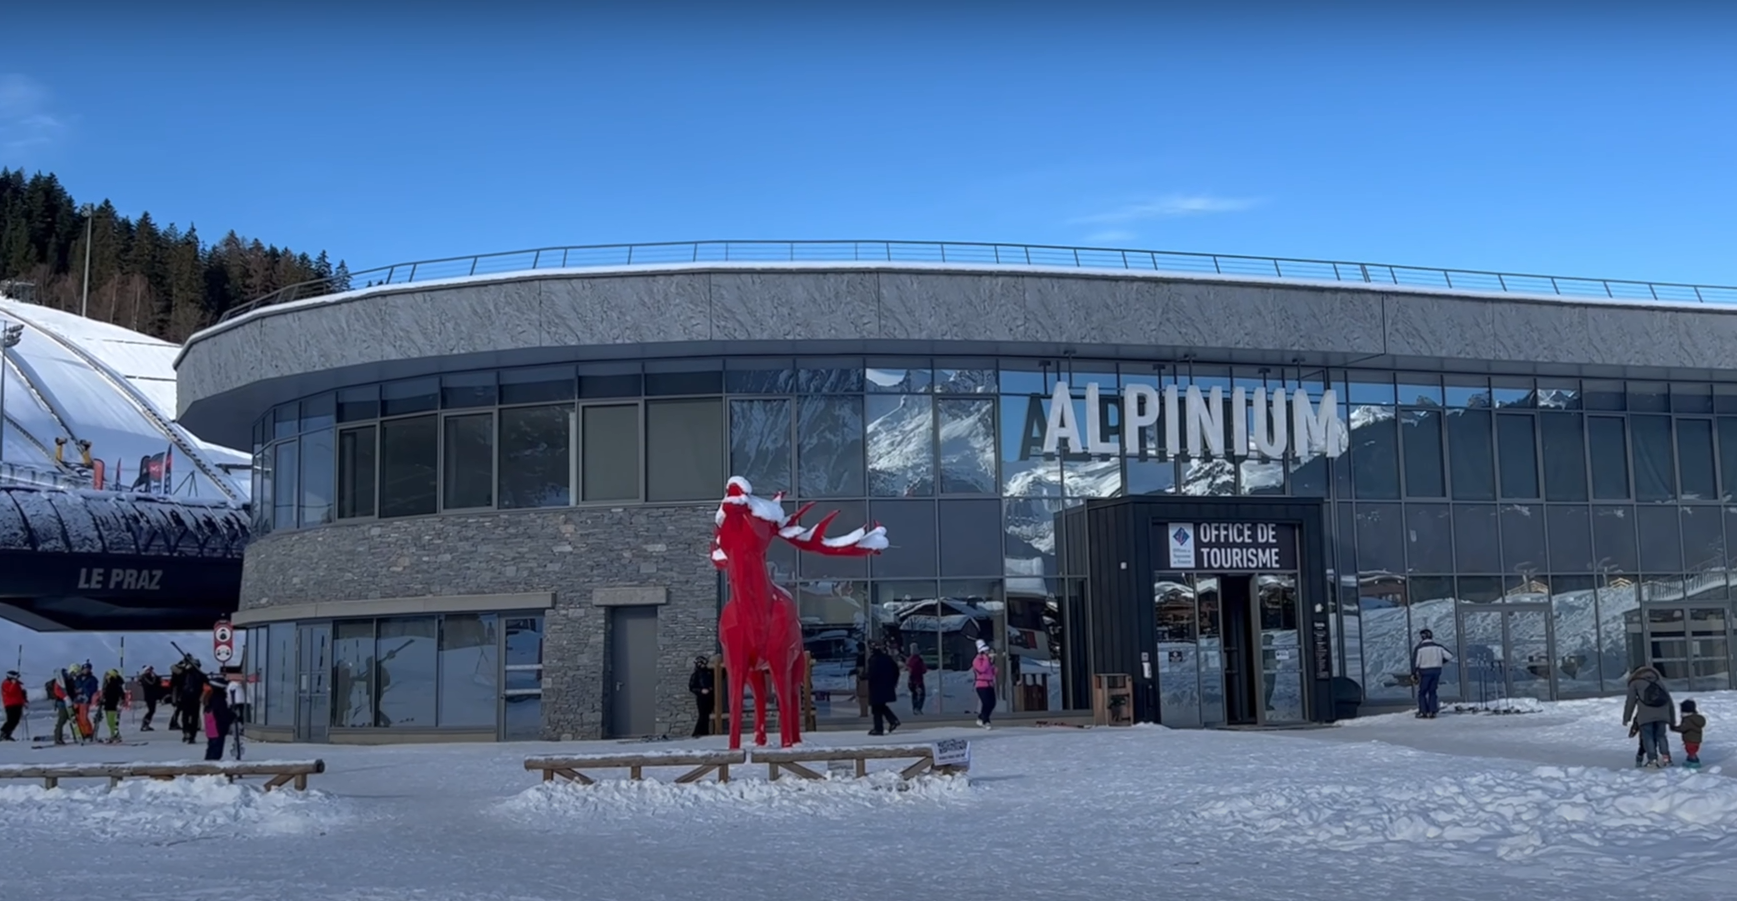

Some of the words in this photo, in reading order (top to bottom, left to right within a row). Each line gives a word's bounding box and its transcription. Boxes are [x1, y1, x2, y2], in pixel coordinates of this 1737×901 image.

[1043, 381, 1339, 459] ALPINIUM
[1200, 522, 1253, 543] OFFICE
[1257, 523, 1277, 543] DE
[1200, 547, 1280, 568] TOURISME
[77, 567, 105, 589] LE
[108, 568, 163, 590] PRAZ
